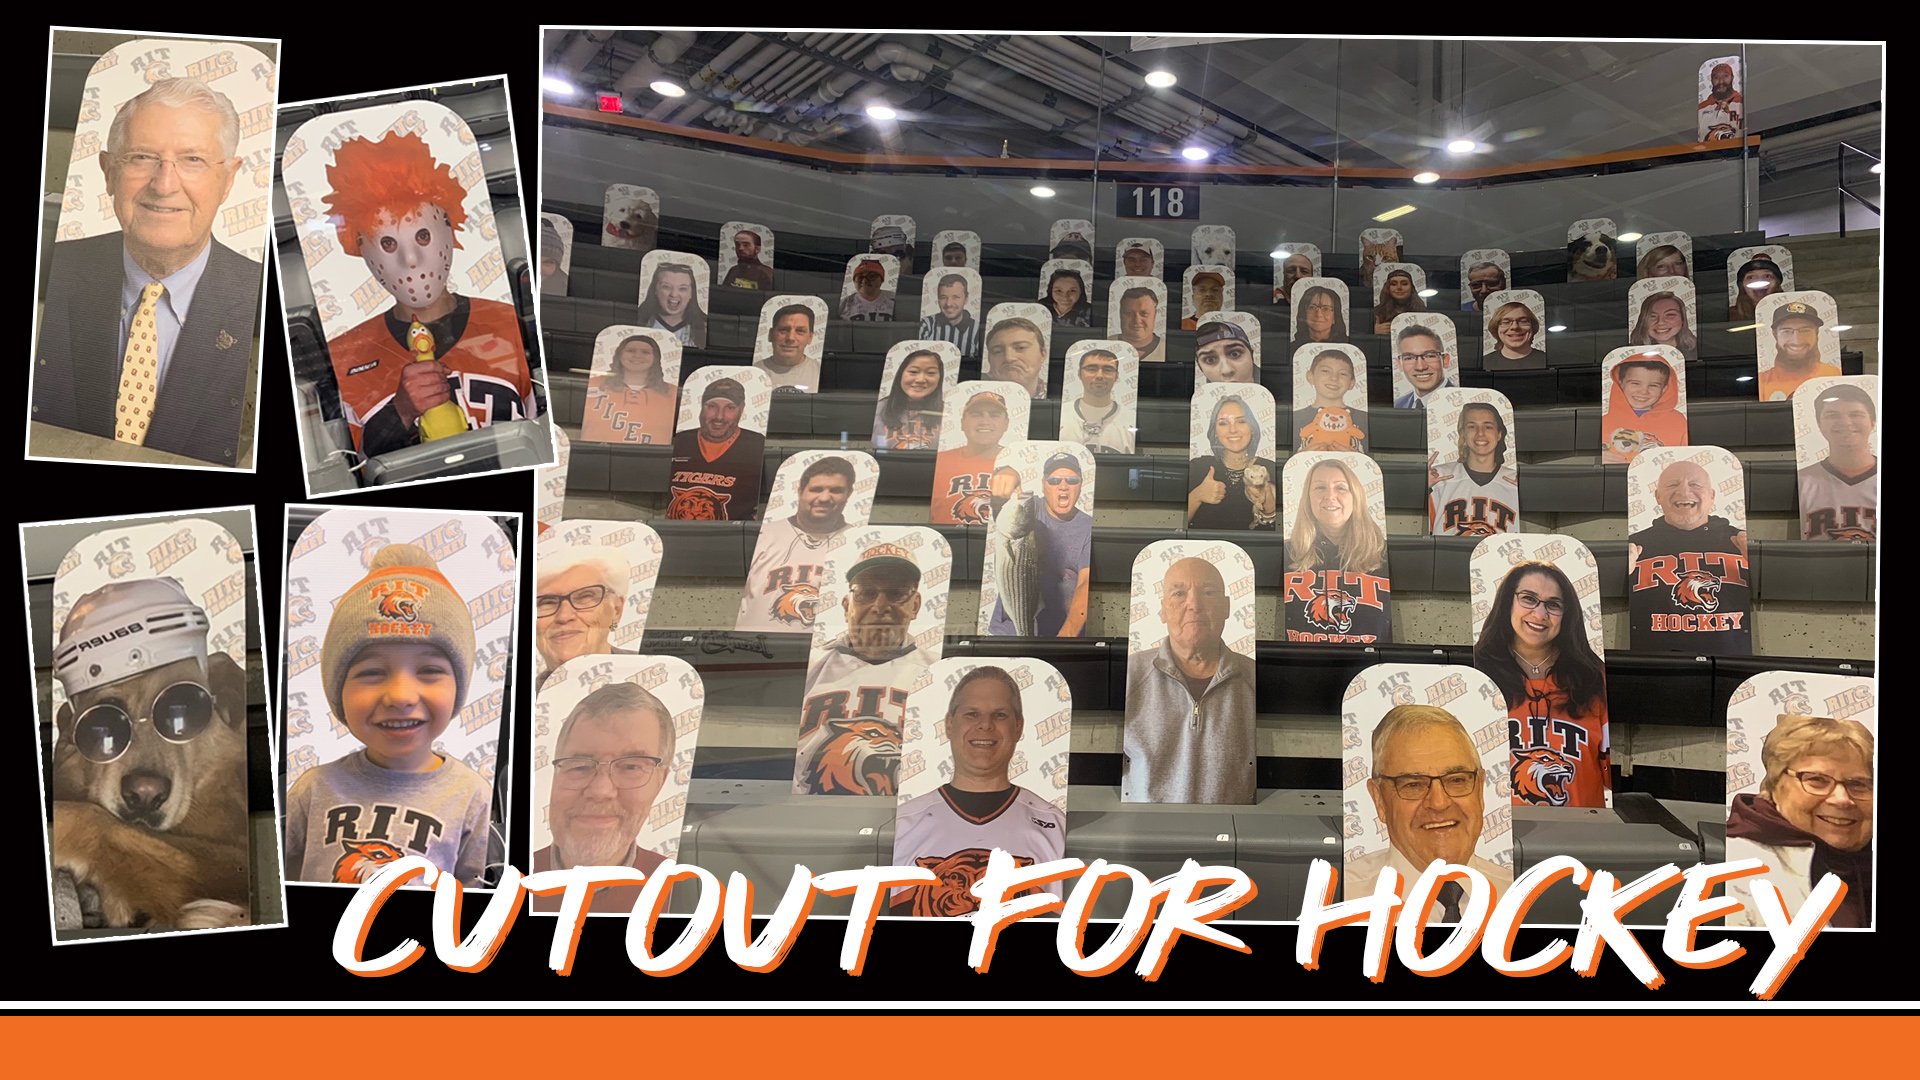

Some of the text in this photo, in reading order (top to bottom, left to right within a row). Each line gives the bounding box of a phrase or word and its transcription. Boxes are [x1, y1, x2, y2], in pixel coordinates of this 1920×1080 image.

[130, 48, 170, 74] RIT
[1132, 187, 1184, 217] 118
[673, 470, 736, 487] TIGERS
[1443, 496, 1517, 533] RIT
[341, 517, 389, 554] RIT
[94, 536, 130, 570] RIT
[861, 545, 910, 561] HOCKEY
[1633, 552, 1749, 592] RIT
[369, 580, 430, 601] RIT
[1284, 569, 1391, 611] RIT
[368, 621, 433, 637] HOCKEY
[1651, 611, 1745, 632] HOCKEY
[1286, 629, 1378, 643] HOCKEY
[578, 662, 613, 687] RIT
[1377, 671, 1410, 698] RIT
[1768, 680, 1807, 706] RIT
[324, 804, 443, 855] RIT
